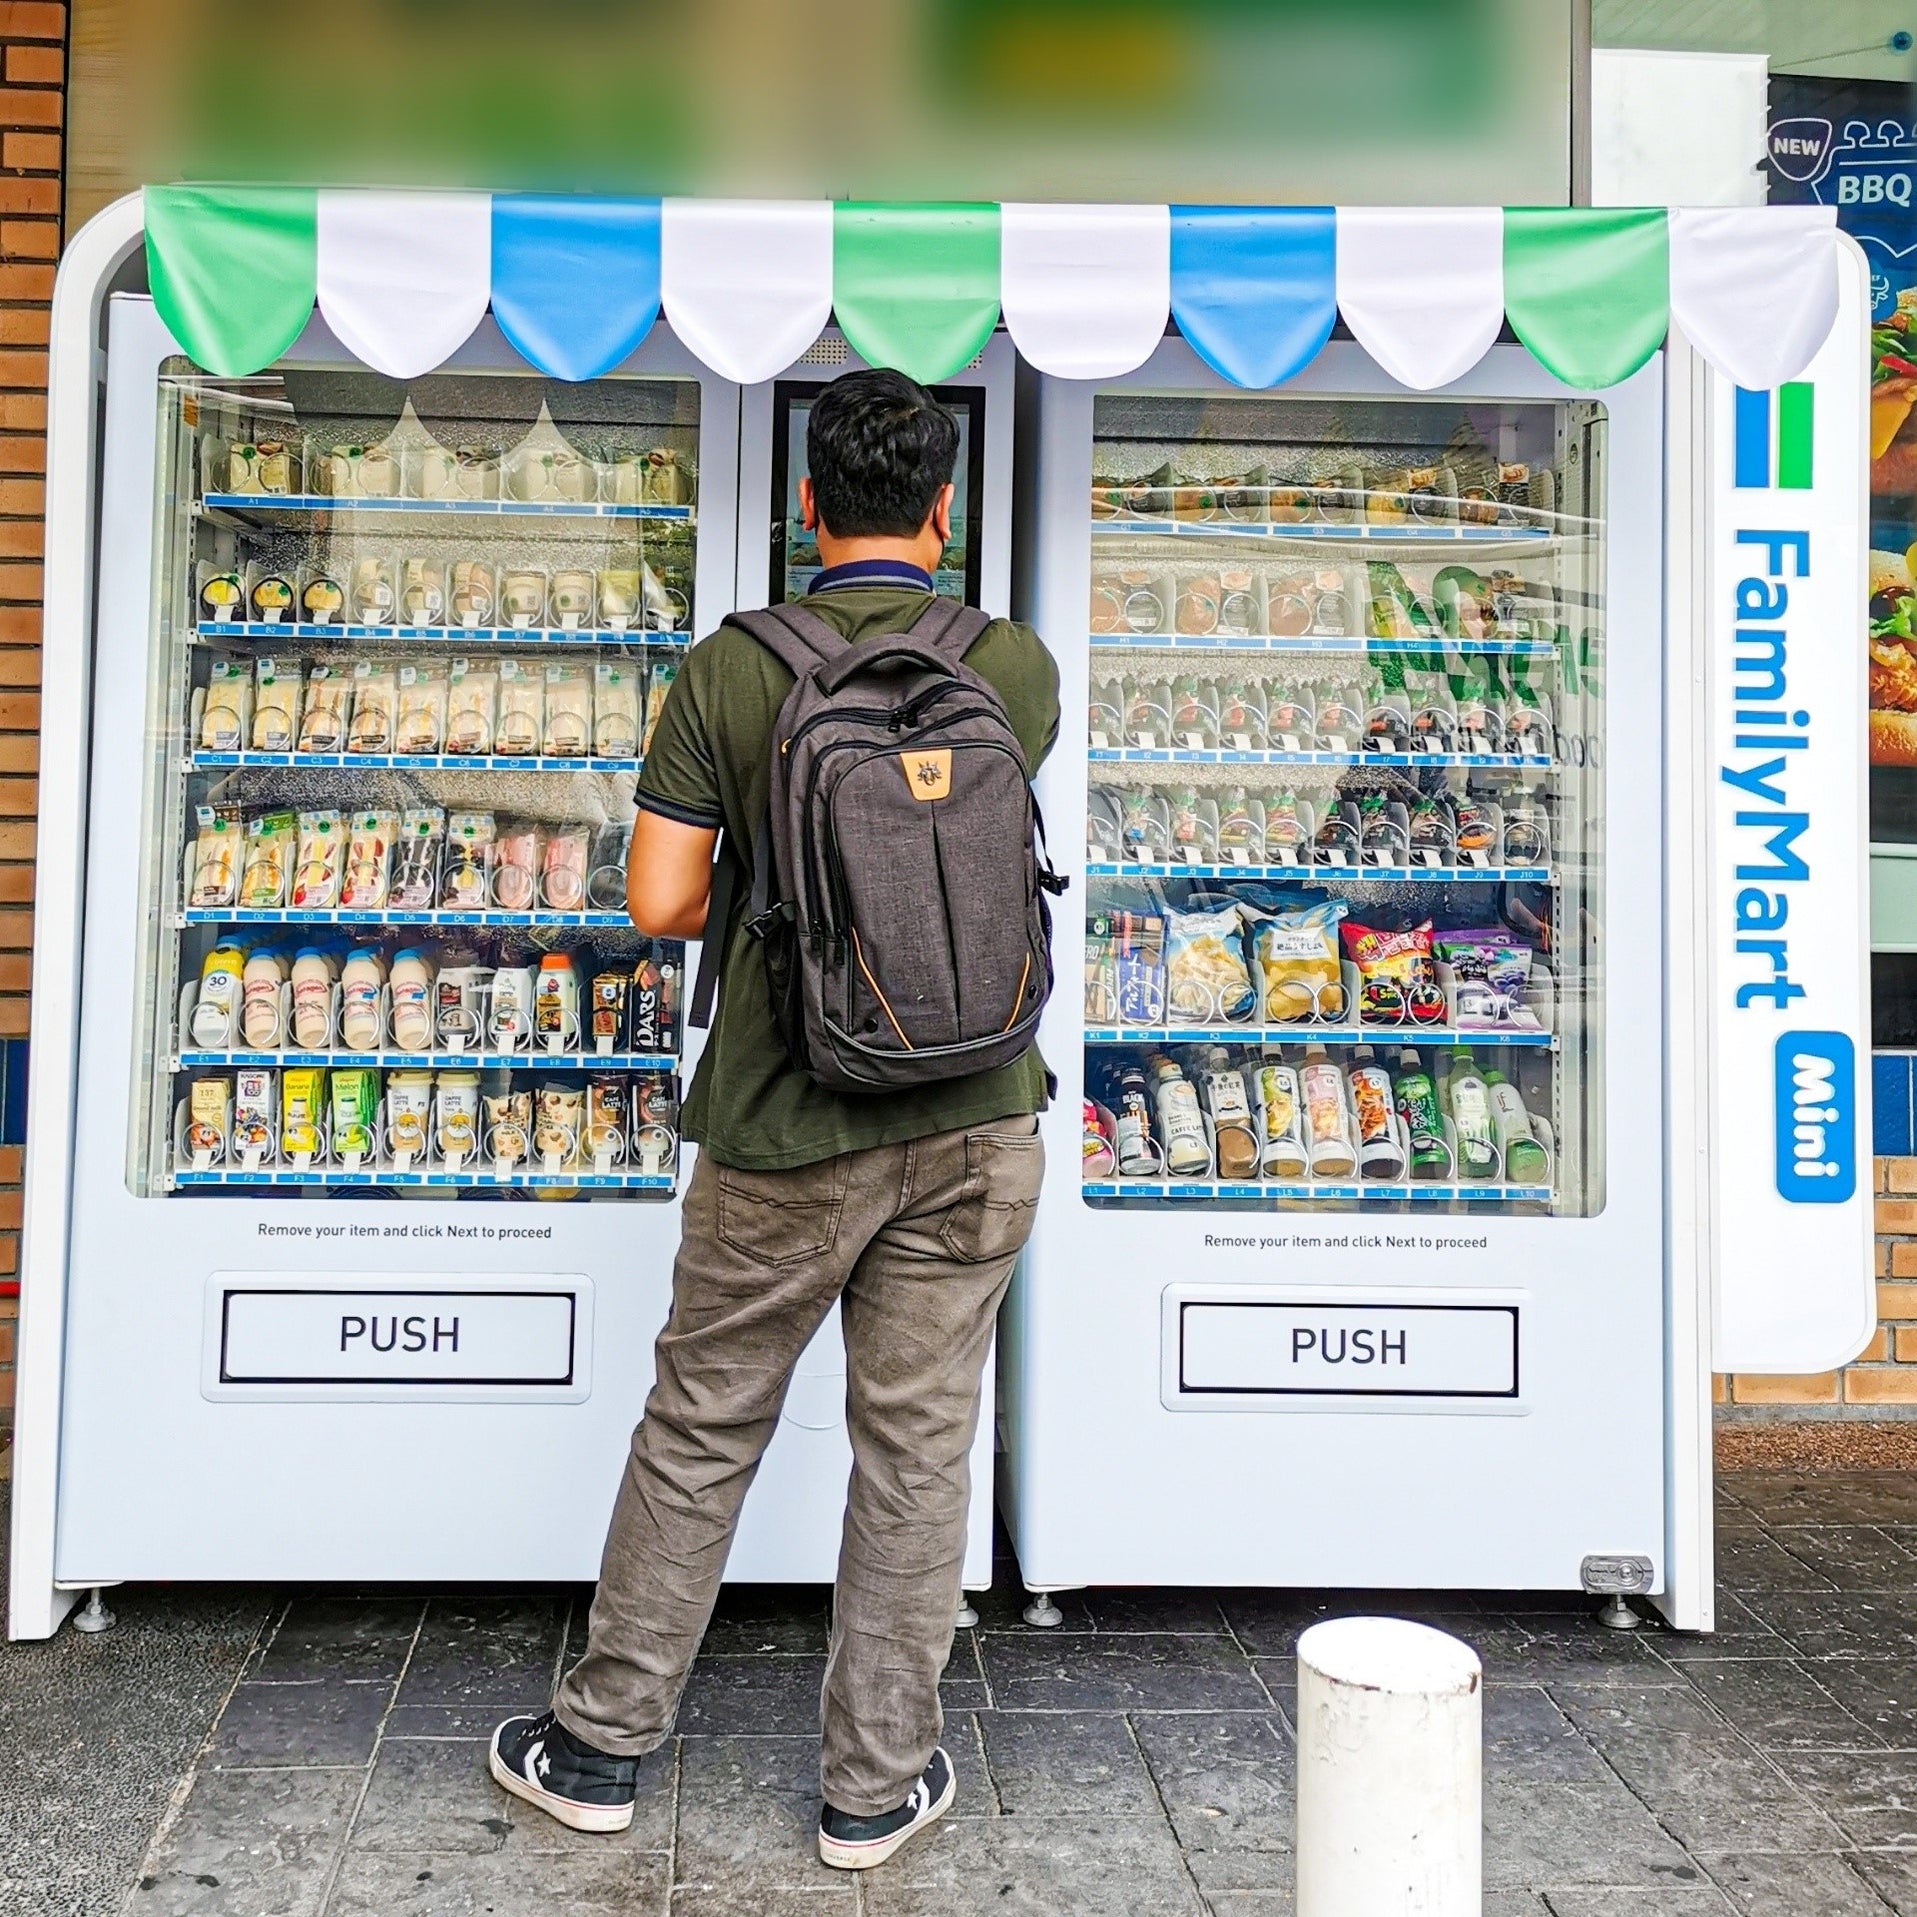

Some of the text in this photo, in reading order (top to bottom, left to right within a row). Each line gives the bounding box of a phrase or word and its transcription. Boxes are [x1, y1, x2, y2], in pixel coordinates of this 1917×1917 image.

[1774, 138, 1820, 156] NEW
[1838, 173, 1912, 208] BBQ
[1720, 529, 1811, 1009] FamilyMart
[210, 976, 227, 986] 30
[636, 990, 656, 1047] DARS
[1122, 1093, 1144, 1104] BLACK
[1793, 1053, 1840, 1177] Mini
[258, 1223, 552, 1240] Remove your item and click Next to proceed
[1204, 1234, 1487, 1251] Remove your item and click Next to proceed
[340, 1316, 460, 1352] PUSH
[1292, 1328, 1406, 1364] PUSH
